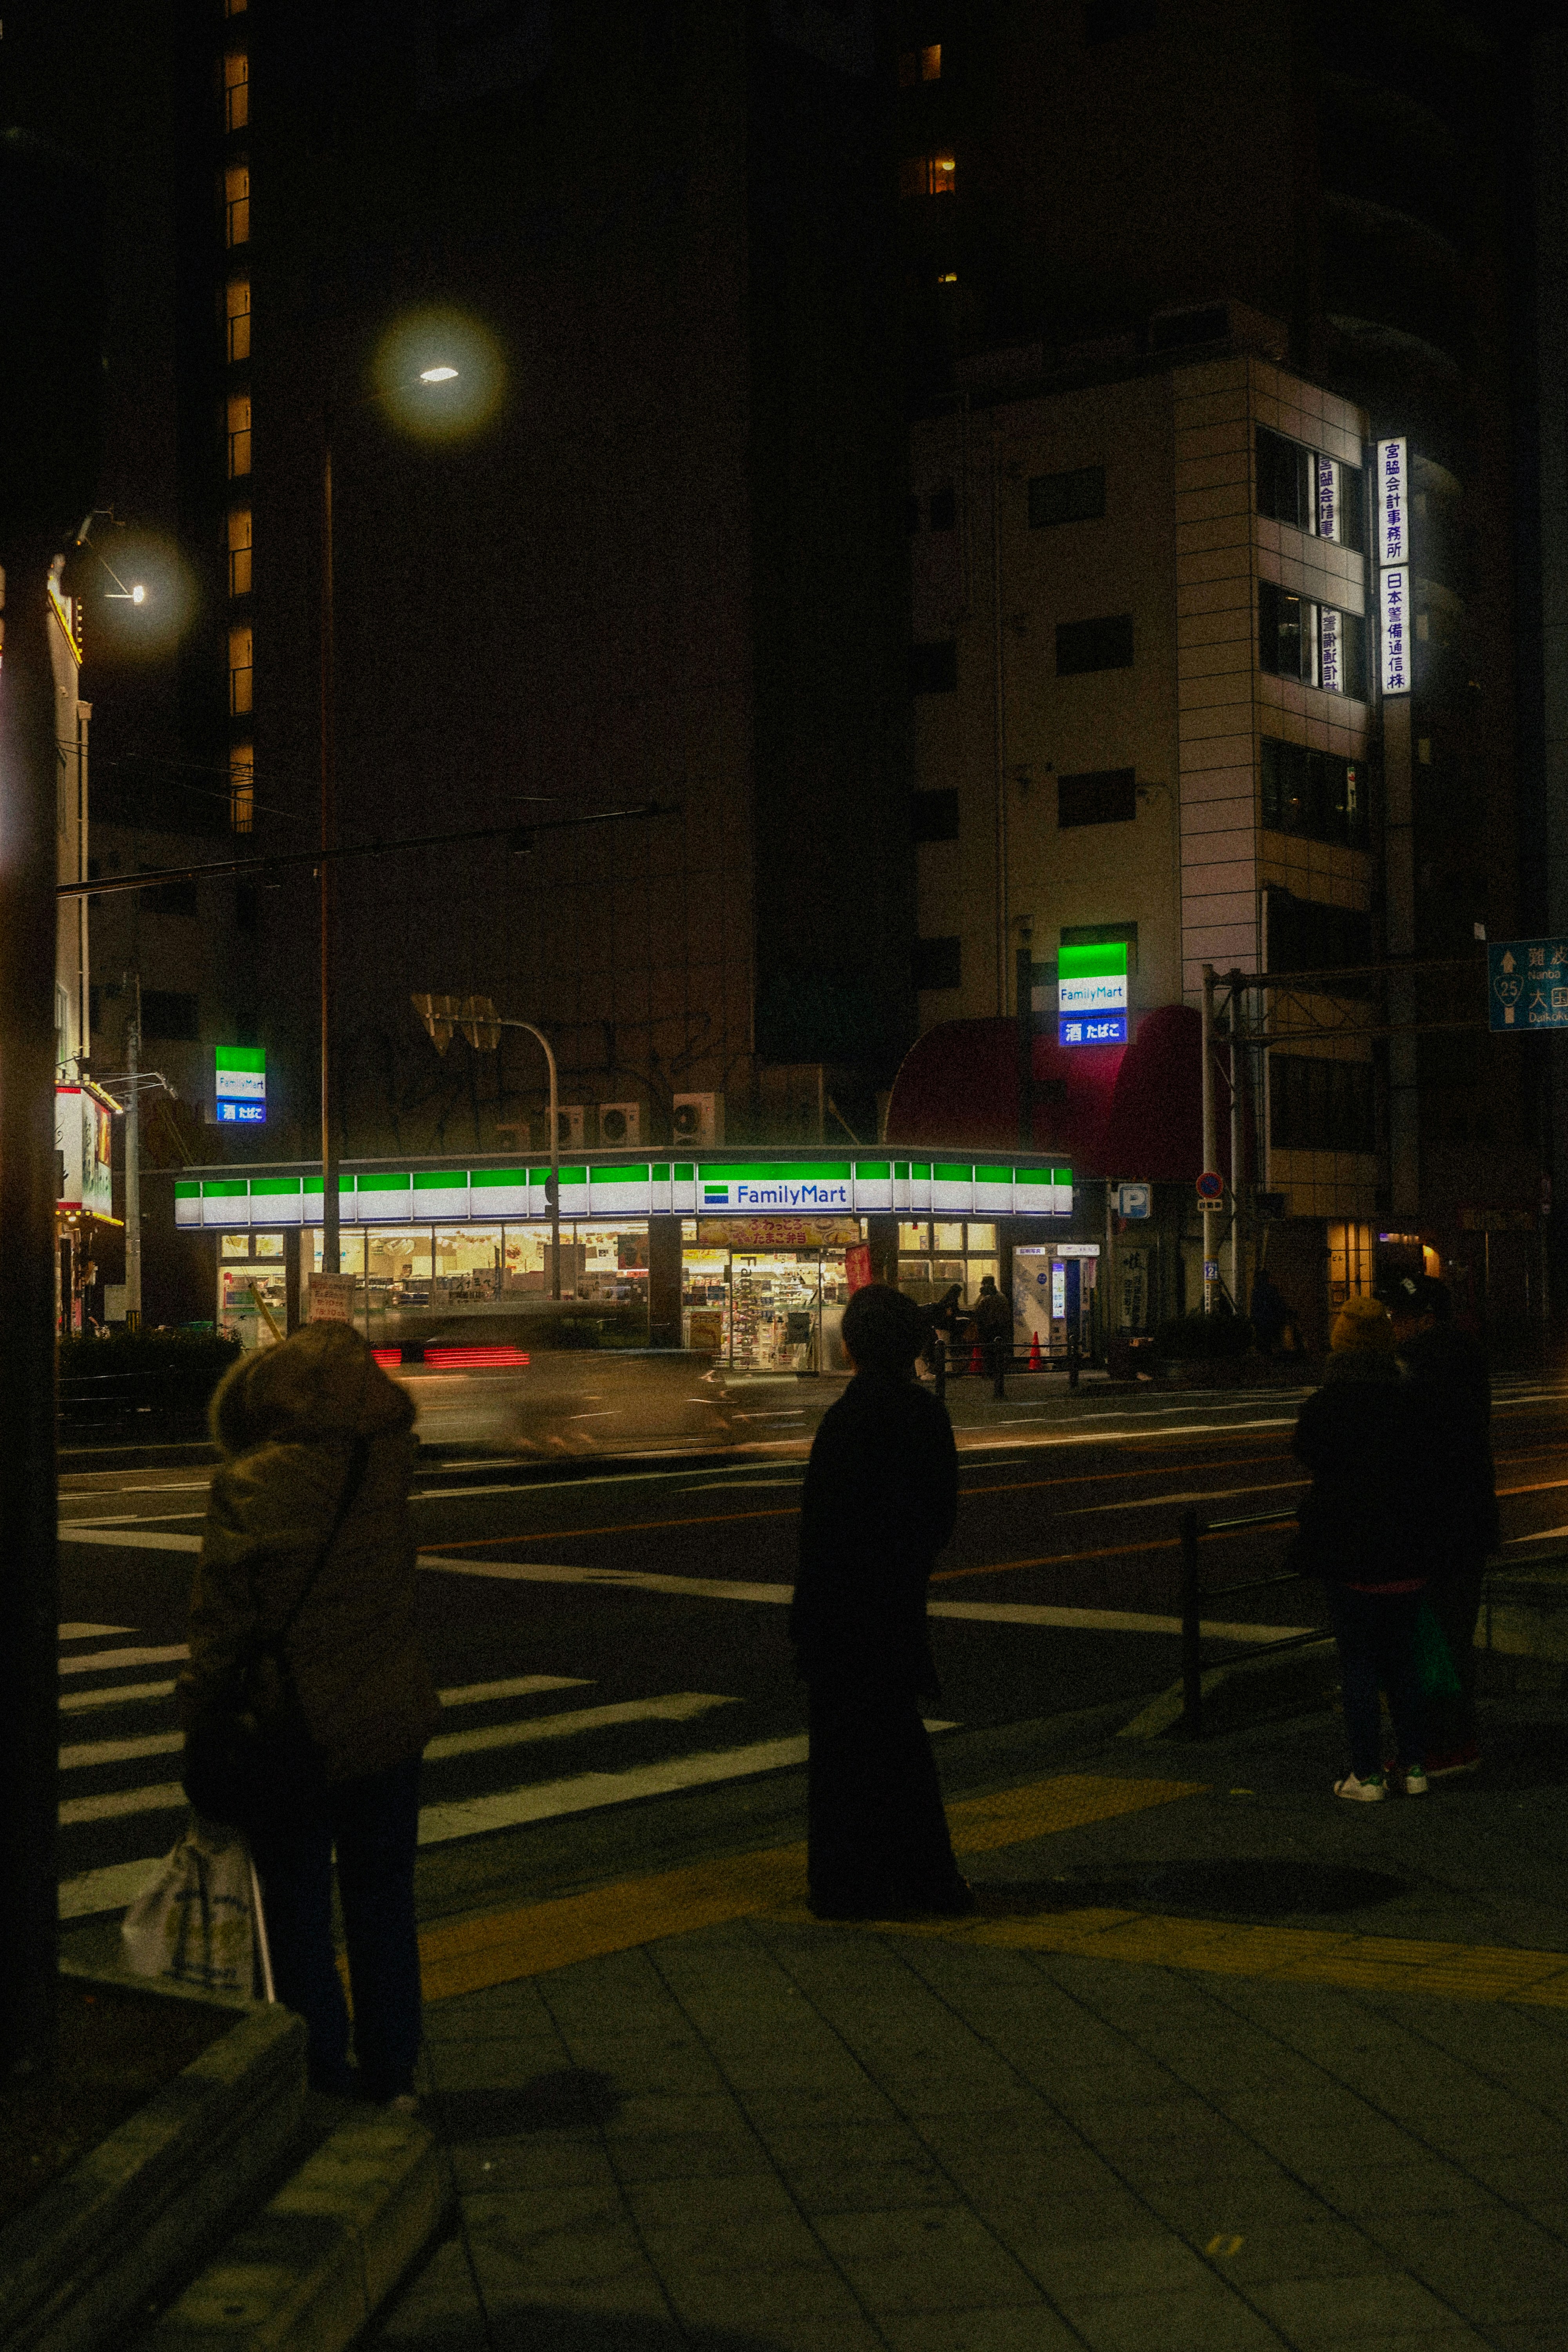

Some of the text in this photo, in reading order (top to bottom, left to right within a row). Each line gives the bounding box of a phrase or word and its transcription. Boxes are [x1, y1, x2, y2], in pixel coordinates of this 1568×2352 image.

[1385, 443, 1401, 558] 宮脇会計事務所
[1528, 970, 1561, 980] Nanba
[1061, 986, 1122, 1002] FamilyMart
[1501, 981, 1518, 996] 25
[1065, 1023, 1120, 1042] 酒 たばこ
[220, 1077, 264, 1090] FamilyMart
[239, 1107, 262, 1119] たばこ
[738, 1185, 846, 1205] FamilyMart
[1123, 1190, 1145, 1213] P
